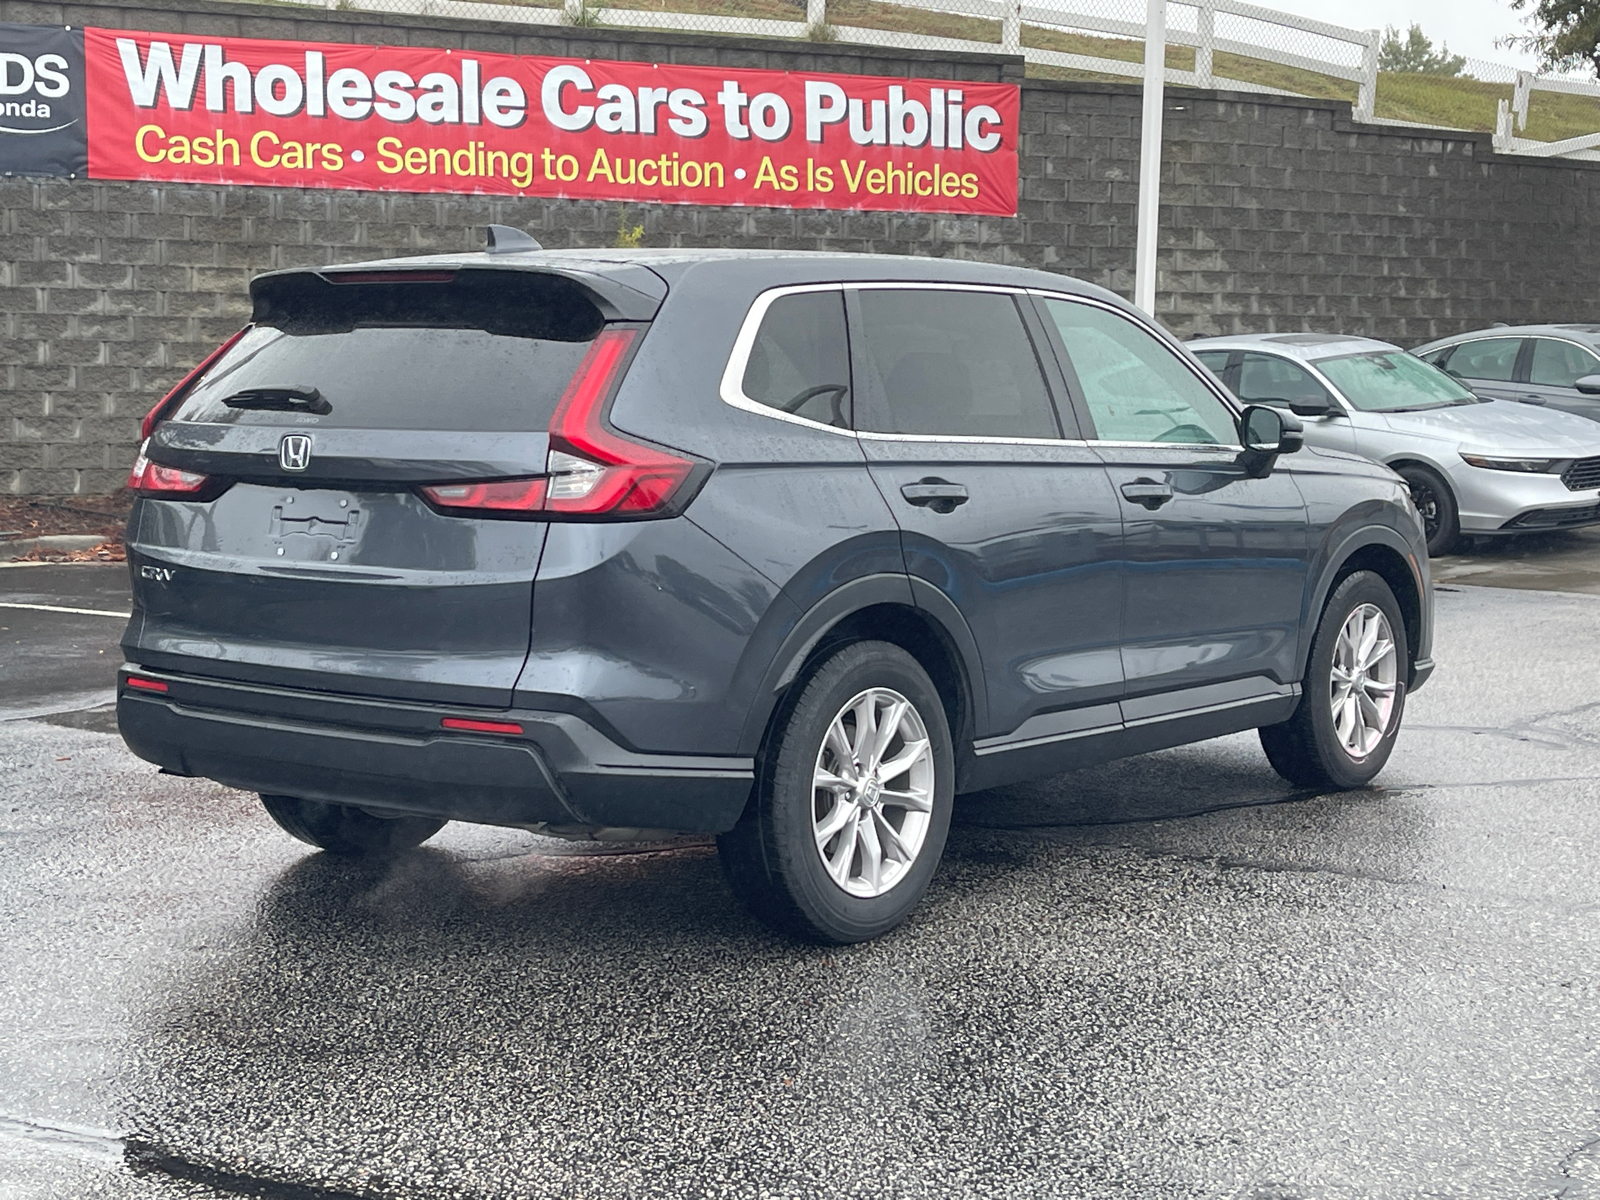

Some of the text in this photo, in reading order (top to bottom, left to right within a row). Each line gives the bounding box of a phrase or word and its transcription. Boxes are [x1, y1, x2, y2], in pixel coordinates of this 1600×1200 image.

[0, 52, 70, 98] DS
[116, 38, 1002, 152] Wholesale Cars to Public
[135, 124, 980, 198] Cash Cars Sending to Auction As Is Vehicles
